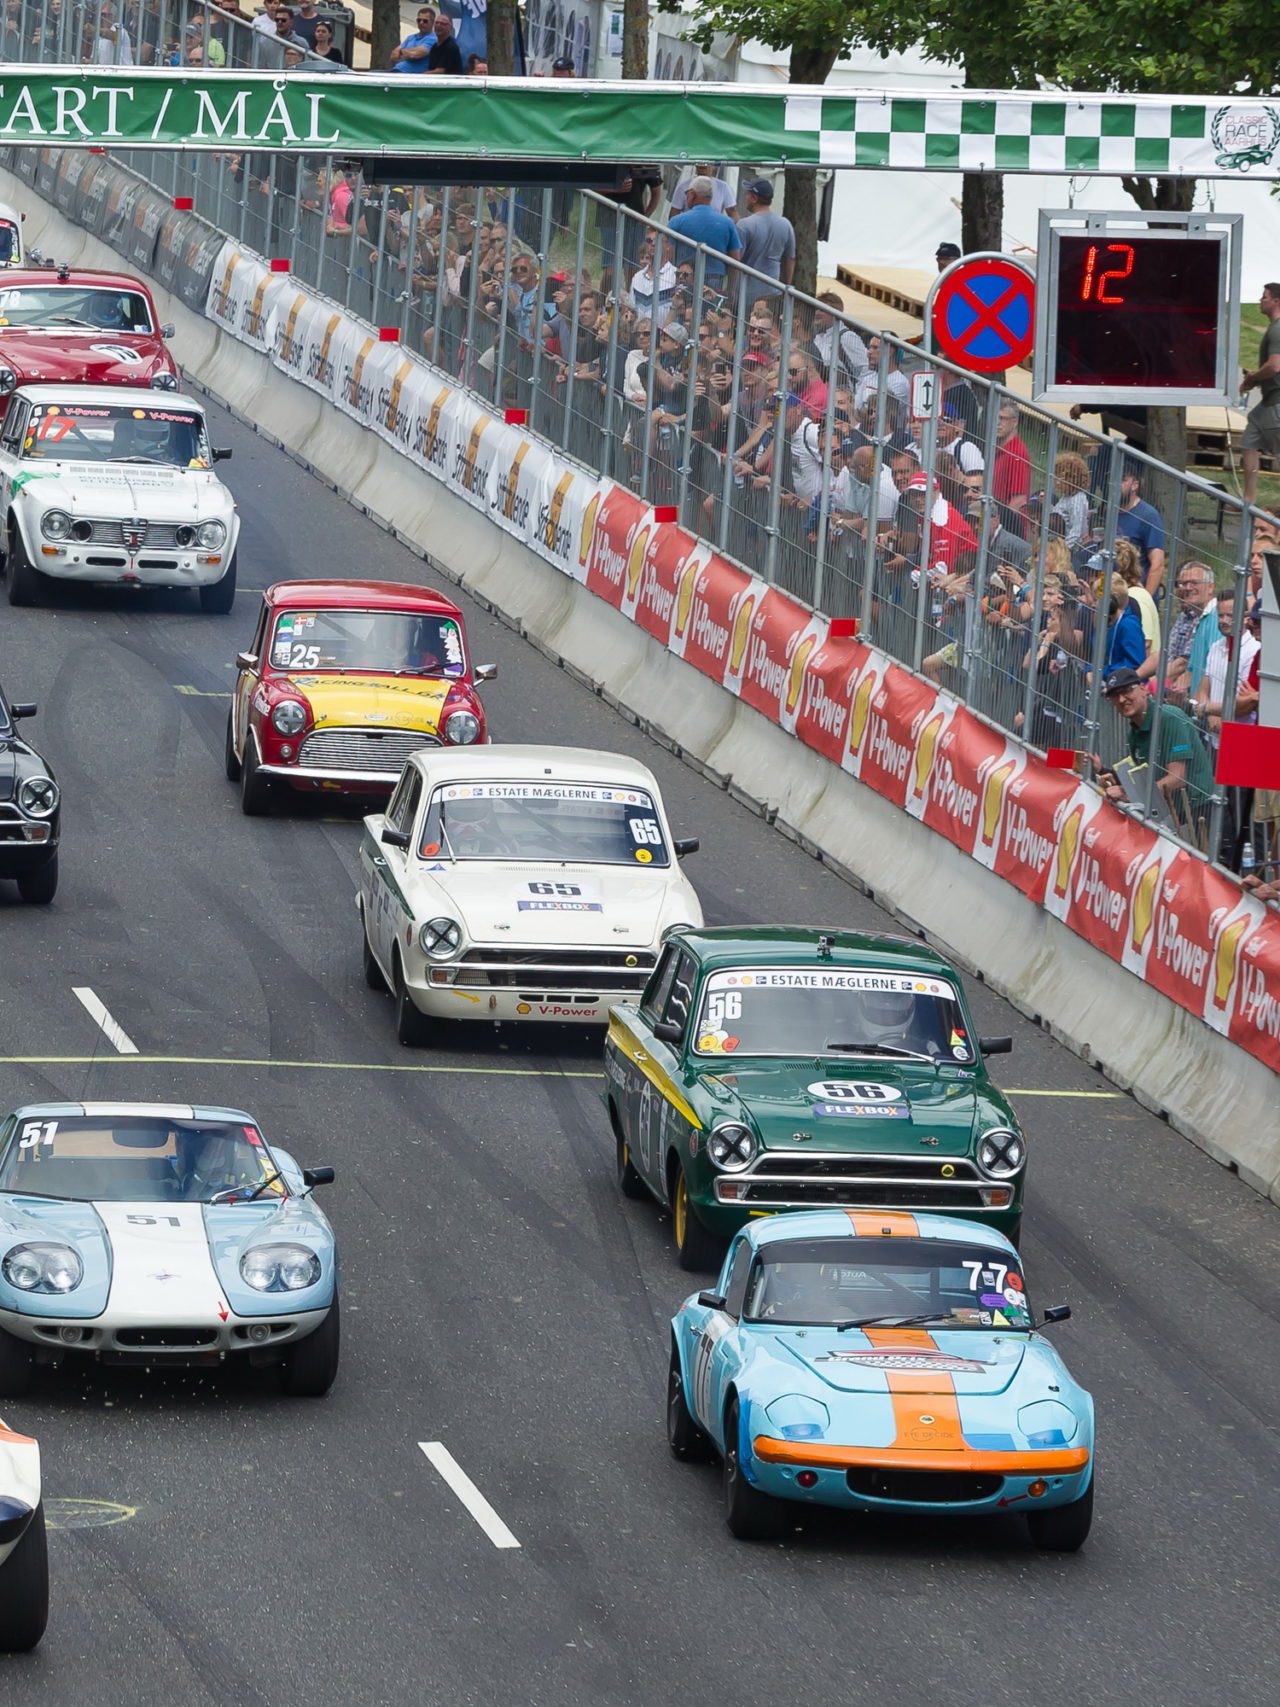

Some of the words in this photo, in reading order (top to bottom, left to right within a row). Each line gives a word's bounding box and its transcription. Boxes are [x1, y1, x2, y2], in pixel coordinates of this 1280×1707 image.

[151, 88, 173, 139] /
[194, 79, 340, 143] MÅL
[1225, 116, 1268, 124] CLASSIC
[1224, 138, 1267, 146] AARHUS
[1225, 124, 1267, 137] RACE
[1082, 244, 1134, 304] 12
[64, 408, 111, 417] V-Power
[149, 412, 195, 424] V-Power
[38, 415, 77, 442] 17
[594, 527, 626, 587] V-Power
[692, 597, 729, 660] V-Power
[289, 644, 321, 668] 25
[748, 634, 787, 699] V-Power
[804, 671, 847, 738] V-Power
[869, 711, 911, 782] V-Power
[489, 787, 529, 798] ESTATE
[532, 787, 597, 800] MÆGLERNE
[932, 754, 978, 827] V-Power
[629, 818, 662, 845] 65
[1004, 800, 1053, 875] V-Power
[528, 882, 582, 896] 65
[1075, 851, 1128, 932] V-Power
[530, 902, 590, 911] FLEXBOX
[1156, 905, 1208, 987] V-Power
[771, 975, 818, 986] ESTATE
[822, 976, 897, 991] MÆGLERNE
[538, 1006, 598, 1017] V-Power
[708, 991, 742, 1020] 56
[1239, 960, 1280, 1040] V-Pow
[822, 1084, 885, 1098] 56
[825, 1104, 898, 1117] FLEXBOX
[20, 1121, 59, 1148] 51
[126, 1214, 181, 1227] 51
[962, 1261, 1008, 1293] 77
[923, 1431, 954, 1439] DECIDE
